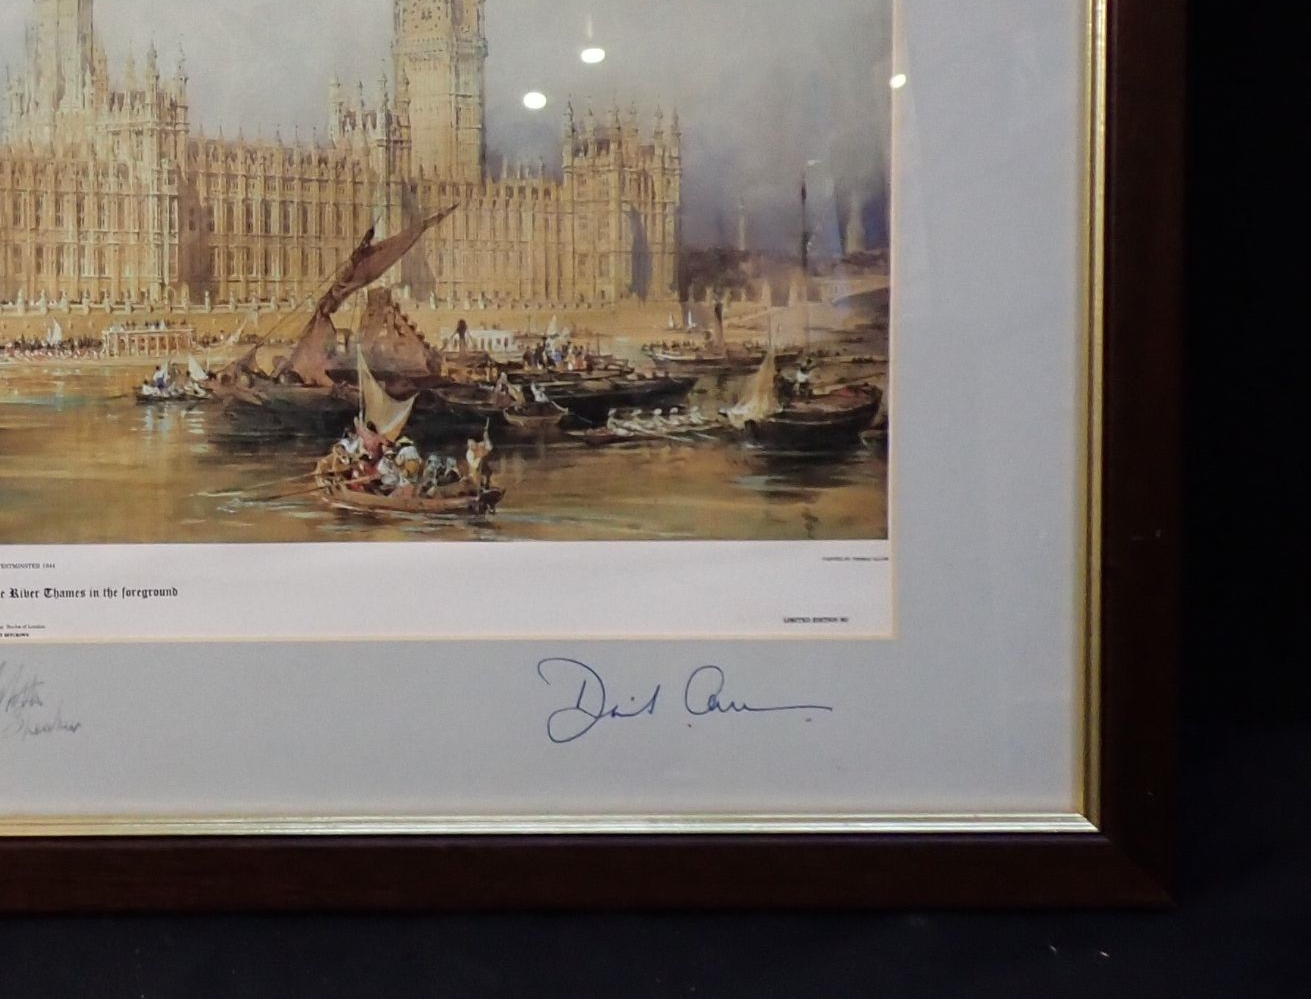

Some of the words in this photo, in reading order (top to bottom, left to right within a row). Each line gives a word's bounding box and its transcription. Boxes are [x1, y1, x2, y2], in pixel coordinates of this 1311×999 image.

[9, 587, 39, 599] River
[43, 587, 86, 599] Thames
[89, 587, 100, 598] in
[103, 587, 118, 599] the
[121, 586, 179, 599] foreground
[537, 657, 661, 743] David
